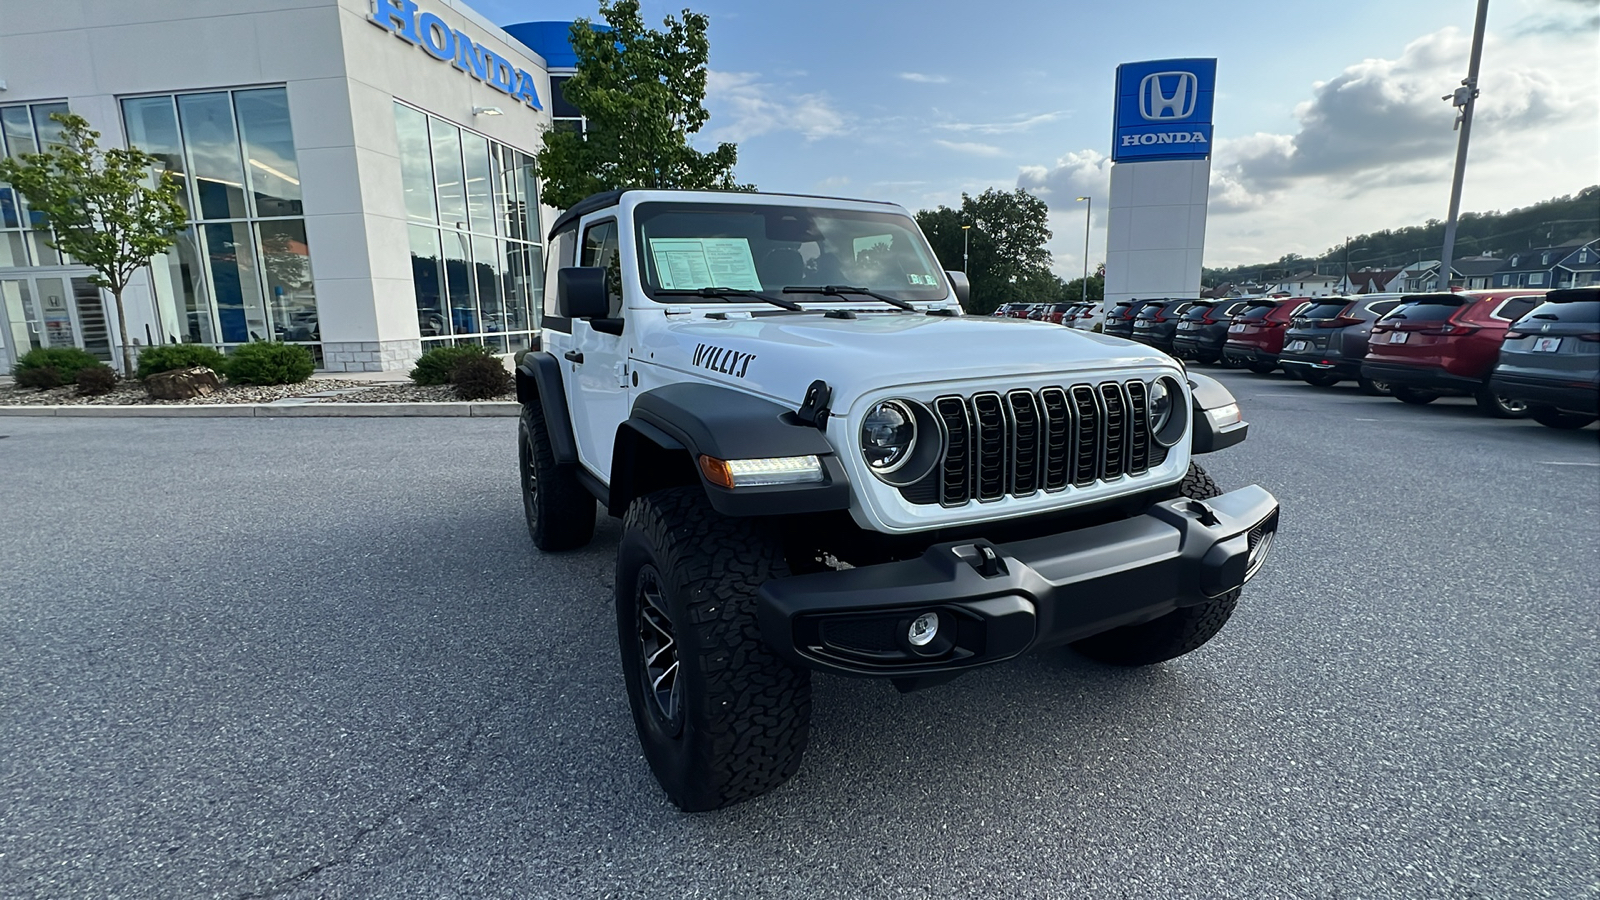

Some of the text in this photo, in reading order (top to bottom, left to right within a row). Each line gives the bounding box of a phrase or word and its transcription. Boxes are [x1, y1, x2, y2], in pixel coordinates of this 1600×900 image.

[367, 0, 543, 111] HONDA
[1121, 132, 1207, 147] HONDA
[692, 343, 756, 378] WILLYS
